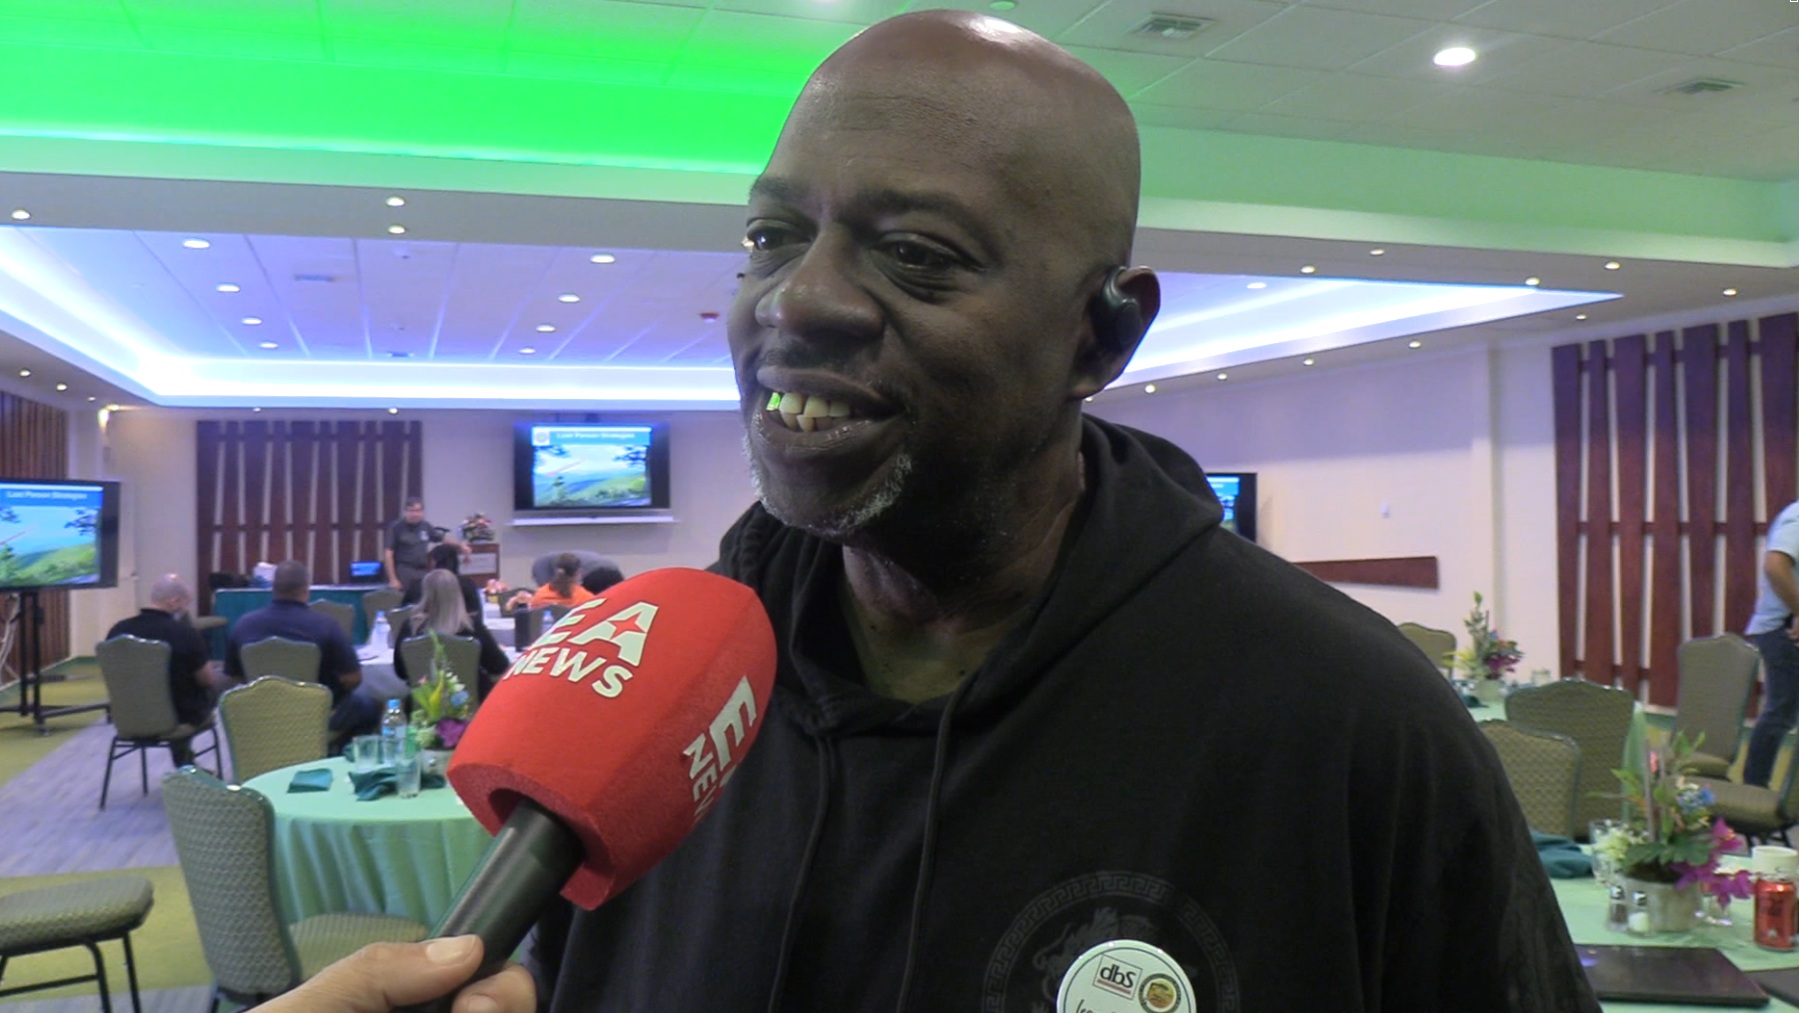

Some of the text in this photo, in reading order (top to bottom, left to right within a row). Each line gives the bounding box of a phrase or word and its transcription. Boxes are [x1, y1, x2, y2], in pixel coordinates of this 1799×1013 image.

[527, 597, 659, 667] EA
[502, 646, 634, 698] NEWS
[708, 674, 757, 789] E
